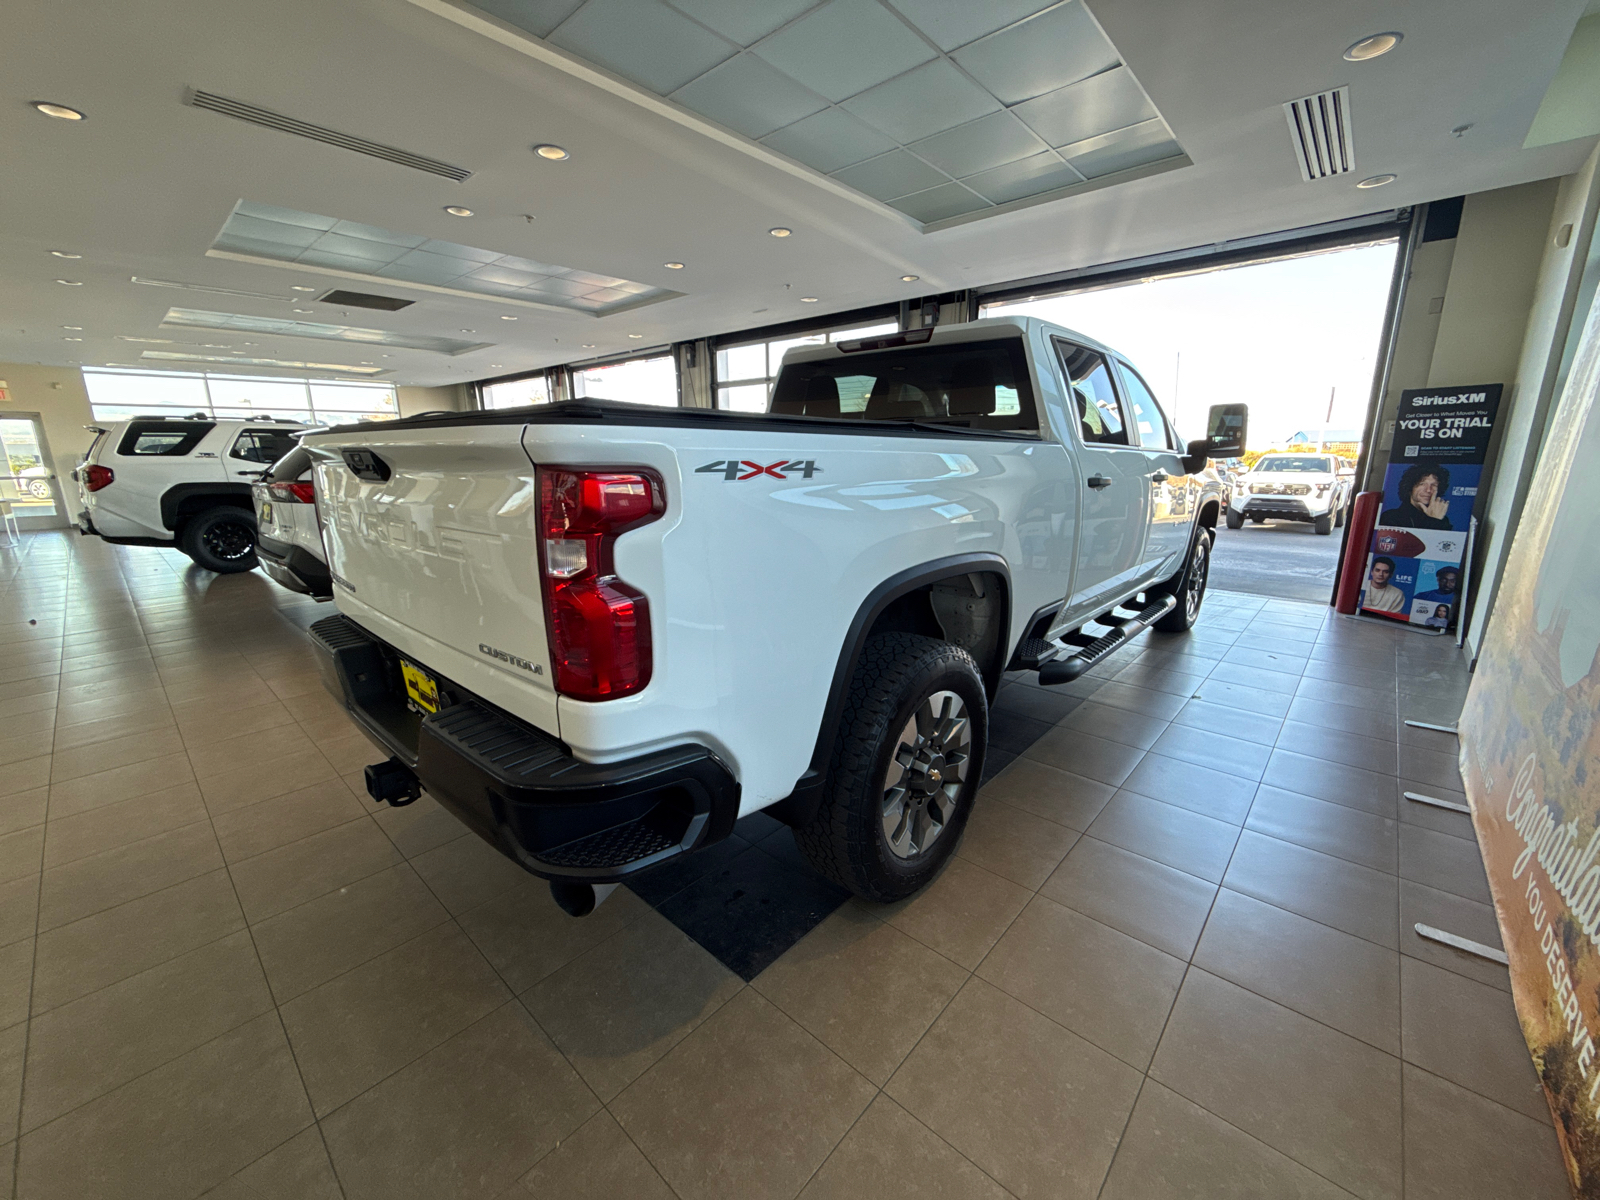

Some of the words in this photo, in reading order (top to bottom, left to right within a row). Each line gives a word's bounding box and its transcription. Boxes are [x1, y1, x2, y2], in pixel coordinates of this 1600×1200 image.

[1412, 393, 1486, 406] SiriusXM
[1399, 419, 1441, 429] YOUR
[1444, 417, 1491, 428] TRIAL
[1420, 429, 1435, 439] IS
[1438, 428, 1463, 439] ON
[1395, 574, 1413, 582] LIFE
[479, 643, 543, 675] CUSTOM
[1524, 871, 1547, 931] YOU
[1540, 922, 1596, 1079] DESERVE
